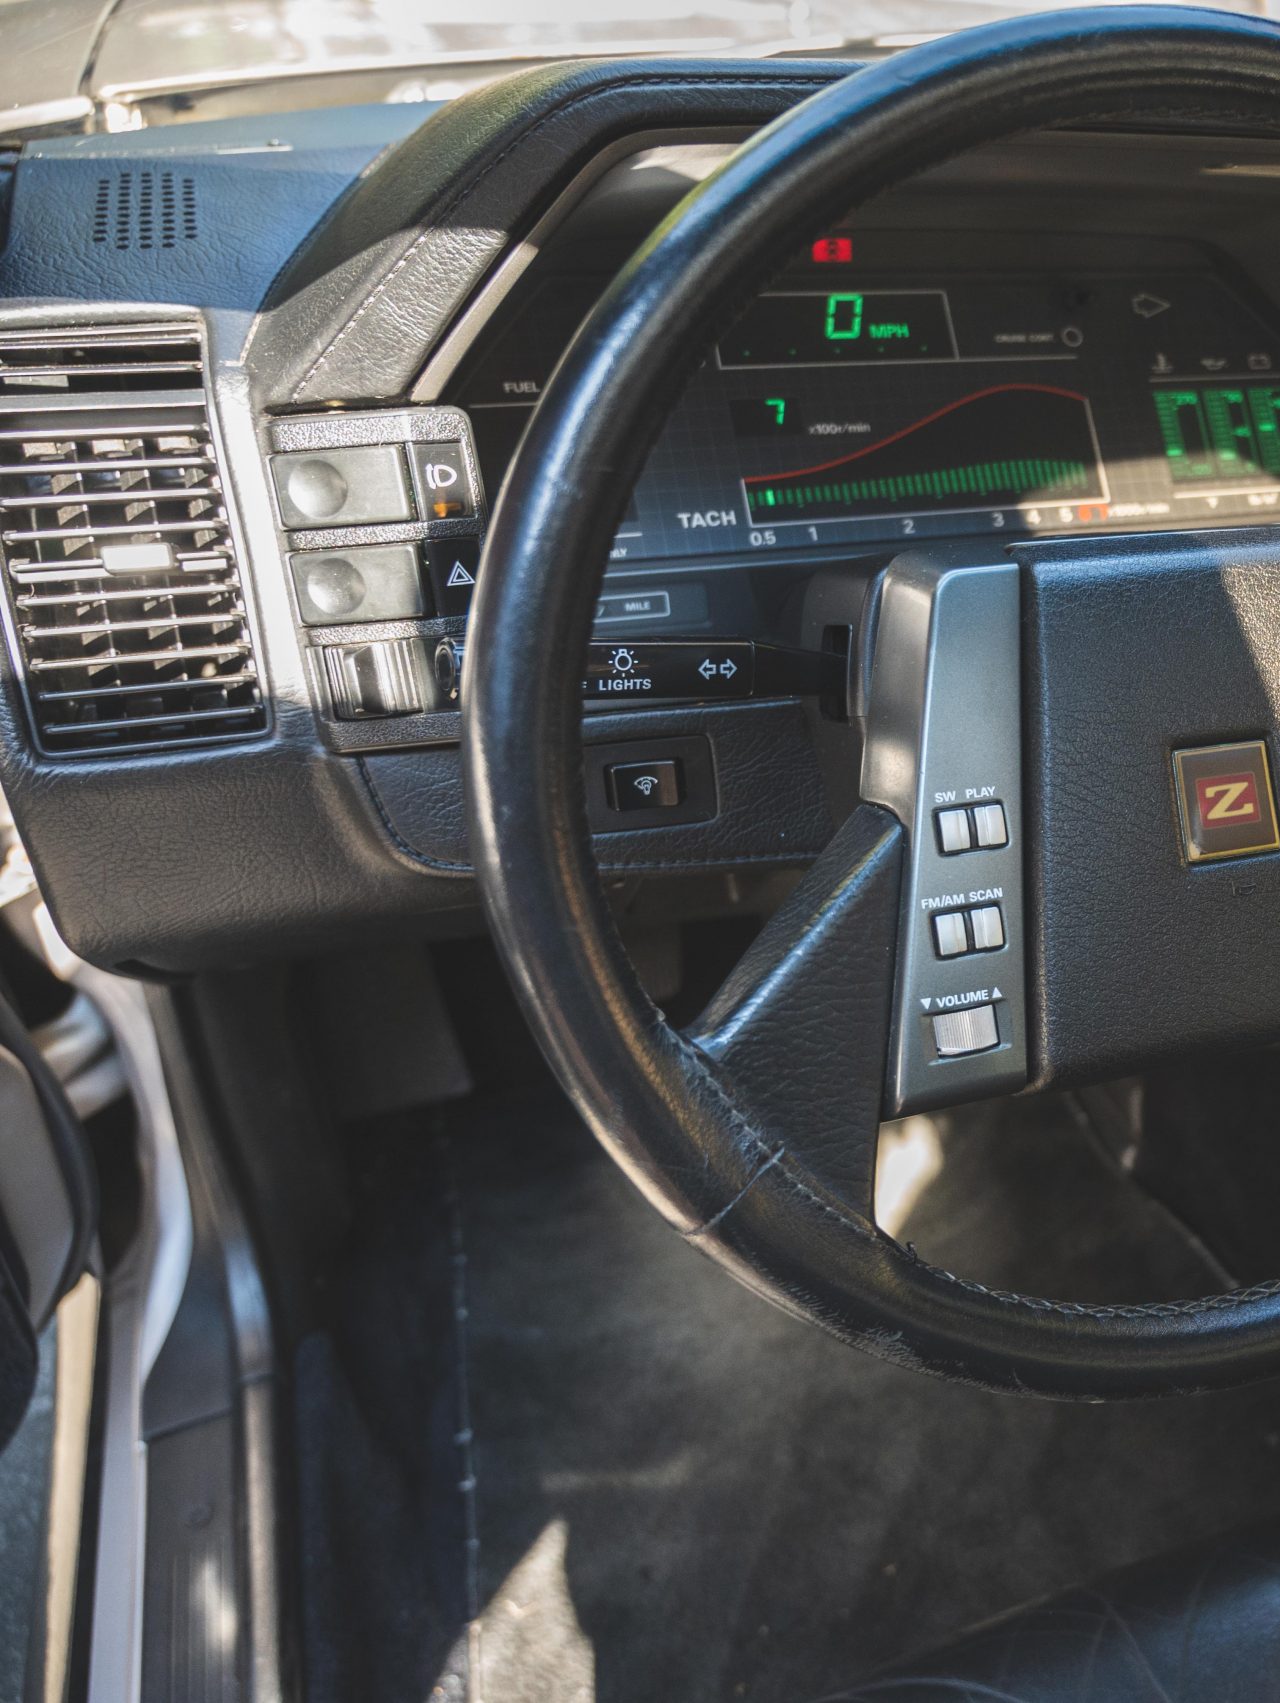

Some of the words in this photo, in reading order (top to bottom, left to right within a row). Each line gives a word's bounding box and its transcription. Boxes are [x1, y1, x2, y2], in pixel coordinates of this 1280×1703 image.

[825, 293, 863, 339] 0
[869, 323, 910, 338] MPH
[503, 381, 541, 393] FUEL
[764, 398, 785, 424] 7
[677, 510, 737, 529] TACH
[749, 530, 776, 546] 0.5
[808, 526, 818, 541] 1
[902, 518, 916, 534] 2
[992, 511, 1005, 528] 3
[1026, 508, 1041, 525] 4
[1058, 506, 1074, 522] 5
[624, 601, 651, 611] MILE
[598, 678, 652, 691] LIGHTS
[934, 790, 956, 803] SW
[965, 785, 996, 799] PLAY
[1205, 781, 1255, 820] Z
[921, 893, 966, 910] FM/AM
[969, 887, 1003, 902] SCAN
[935, 989, 989, 1009] VOLUME
